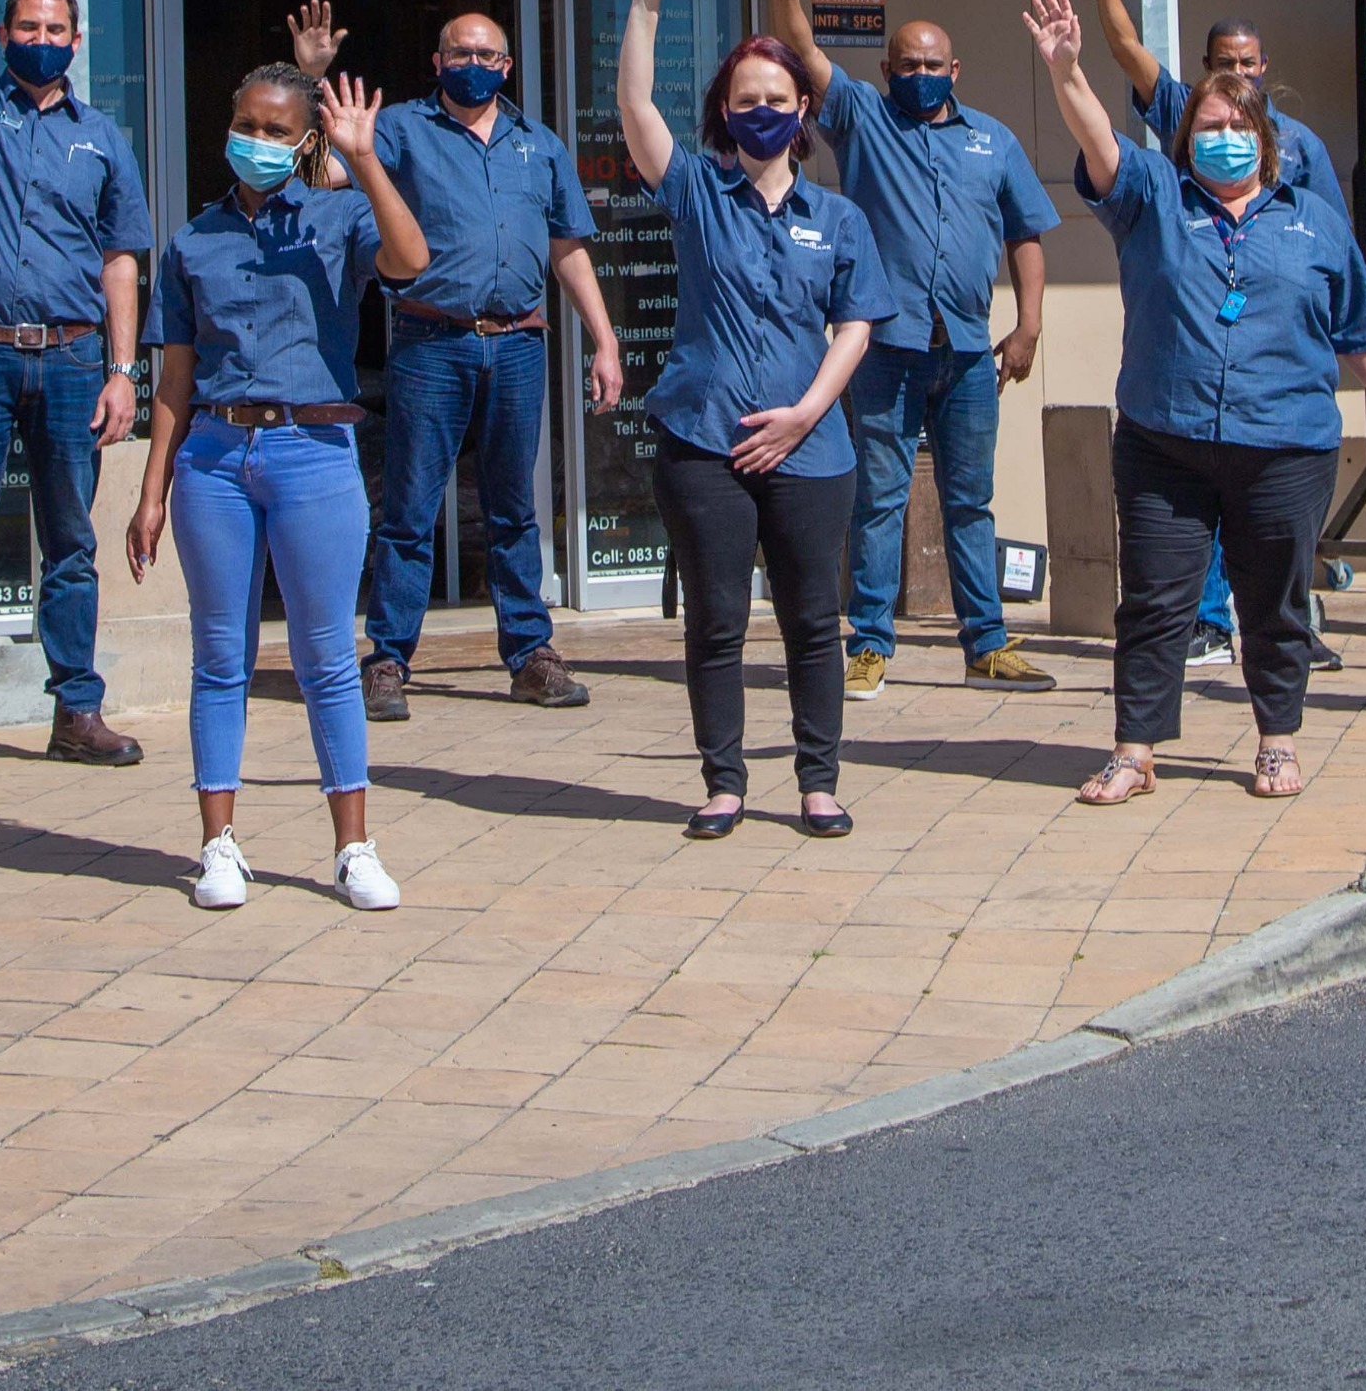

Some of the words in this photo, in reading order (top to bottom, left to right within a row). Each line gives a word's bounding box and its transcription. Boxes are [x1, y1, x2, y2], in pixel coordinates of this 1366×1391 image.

[815, 35, 836, 45] CCTV
[665, 83, 691, 92] OWN
[578, 132, 592, 142] for
[595, 133, 614, 145] any
[577, 156, 616, 180] NO
[591, 227, 633, 243] Credit
[638, 295, 679, 310] availa
[626, 352, 645, 366] Fri
[614, 420, 638, 436] Tel:
[588, 516, 619, 531] ADT
[592, 549, 624, 566] Cell:
[628, 547, 652, 563] 083
